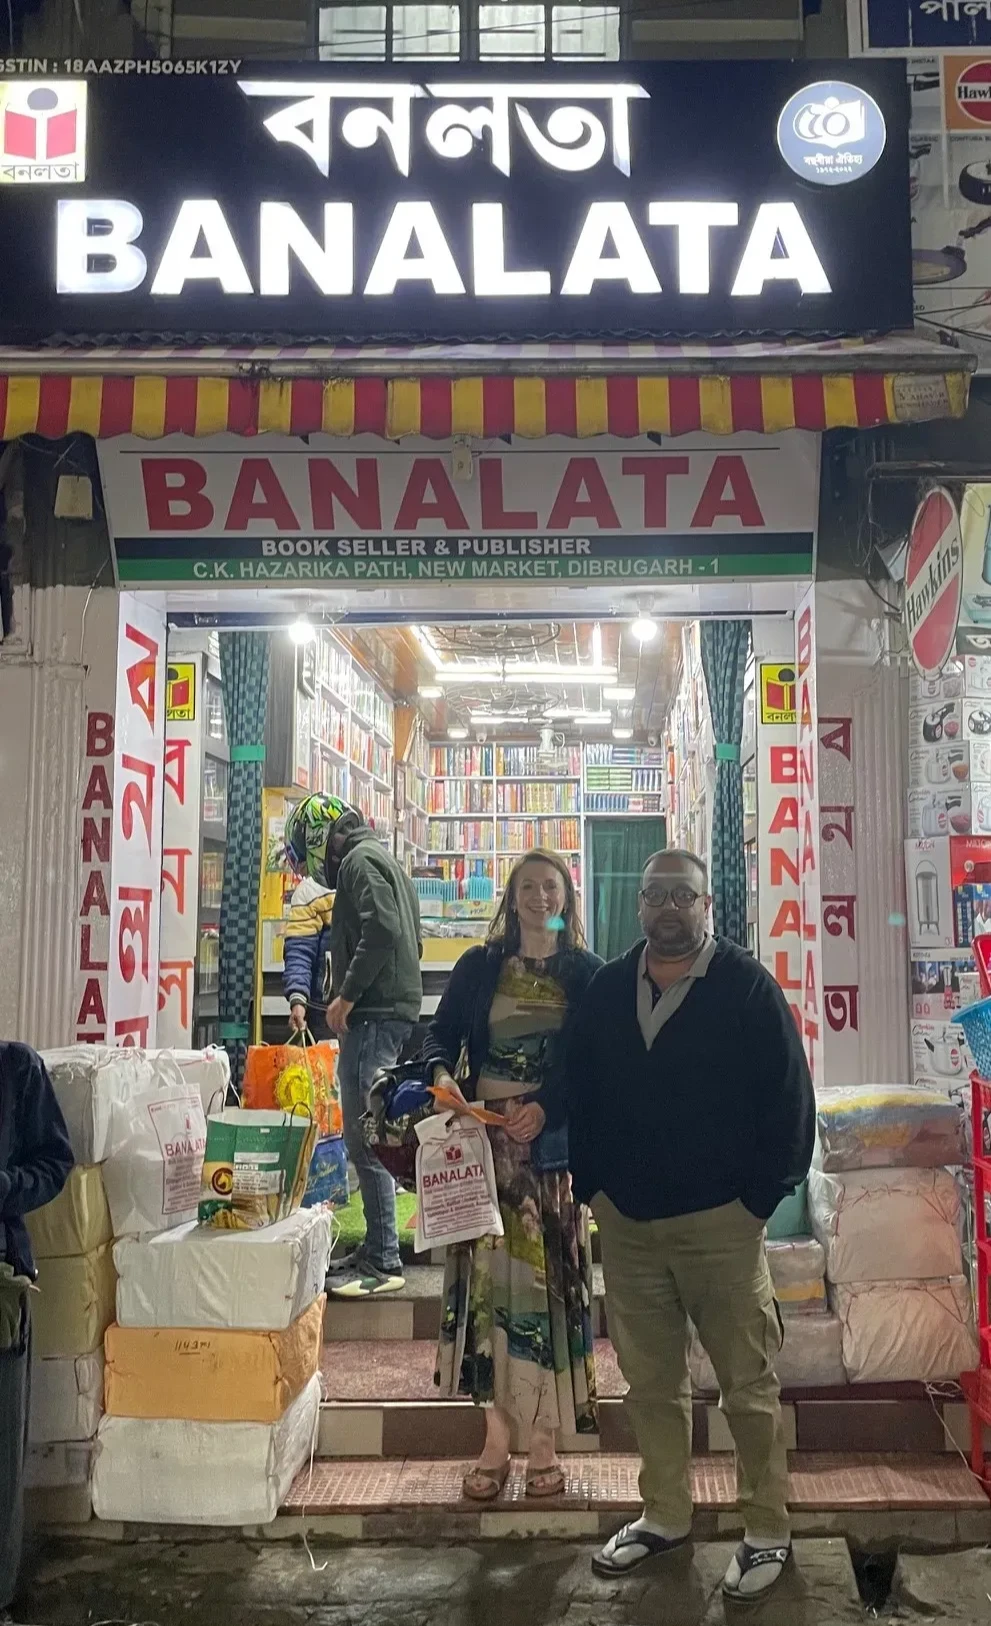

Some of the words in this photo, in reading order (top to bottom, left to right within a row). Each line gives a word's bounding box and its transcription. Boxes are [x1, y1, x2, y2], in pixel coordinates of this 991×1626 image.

[64, 59, 242, 75] 18AAZPH5065K1ZY
[1, 162, 79, 181] বনলতা
[238, 82, 651, 178] বনলতা
[56, 199, 833, 296] BANALATA
[141, 455, 766, 530] BANALATA
[193, 561, 234, 579] C.K.
[240, 560, 349, 578] HAZARIKA
[354, 560, 412, 580] PATH,
[418, 561, 466, 577] NEW
[472, 560, 562, 578] MARKET,
[568, 559, 693, 577] DIBRUGARH
[710, 558, 720, 574] 1
[262, 539, 331, 556] BOOK
[337, 539, 427, 556] SELLER
[433, 539, 450, 556] &
[458, 538, 592, 555] PUBLISHER
[906, 537, 960, 633] Hawkins
[76, 712, 115, 1044] BANALA
[768, 746, 803, 1036] BANAL
[819, 717, 859, 1032] বনলতা
